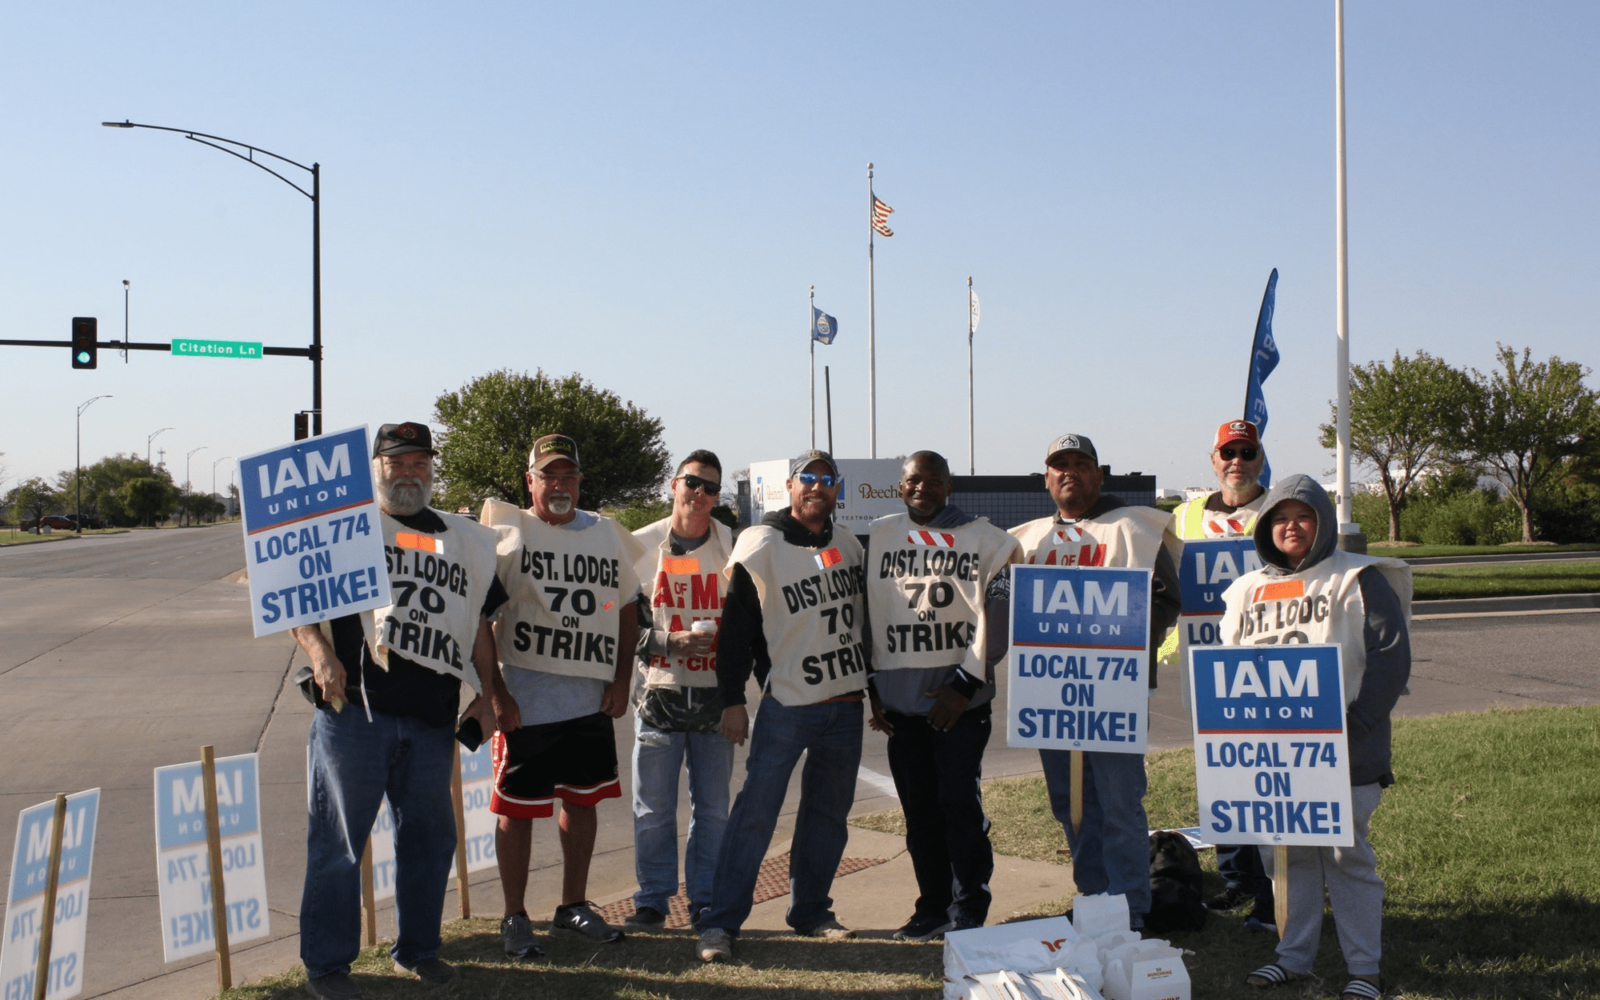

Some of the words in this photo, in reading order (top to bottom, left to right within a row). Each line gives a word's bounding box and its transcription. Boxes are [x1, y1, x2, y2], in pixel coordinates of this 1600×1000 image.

[179, 342, 233, 354] Citation
[239, 345, 256, 355] Ln
[258, 443, 351, 498] IAM
[268, 485, 347, 515] UNION
[859, 483, 903, 499] Beechc
[254, 530, 327, 564] LOCAL
[328, 512, 371, 544] 774
[299, 550, 332, 579] ON
[384, 545, 409, 575] ST.
[414, 551, 468, 598] LODGE
[521, 544, 558, 581] DST.
[563, 553, 619, 589] LODGE
[880, 549, 918, 580] DIST.
[923, 550, 979, 582] LODGE
[261, 566, 379, 624] STRIKE!
[392, 580, 446, 614] 70
[544, 587, 597, 616] 70
[781, 573, 827, 615] DIST.
[824, 565, 864, 601] LODGE
[904, 582, 954, 609] 70
[1032, 579, 1128, 616] IAM
[409, 608, 428, 624] ON
[561, 615, 580, 629] ON
[820, 603, 854, 635] 70
[918, 610, 936, 622] ON
[1038, 622, 1121, 636] UNION
[384, 615, 463, 671] TRIKE
[513, 621, 616, 667] STRIKE
[839, 632, 854, 645] ON
[887, 621, 977, 654] STRIKE
[802, 642, 864, 686] STRI
[1018, 653, 1093, 680] LOCAL
[1097, 656, 1139, 682] 774
[1213, 659, 1320, 698] IAM
[1061, 683, 1094, 708] ON
[1017, 707, 1137, 743] STRIKE!
[1223, 706, 1314, 719] UNION
[1205, 742, 1287, 768] LOCAL
[1290, 742, 1337, 768] 774
[1254, 771, 1291, 797] ON
[1210, 800, 1341, 834] STRIKE!
